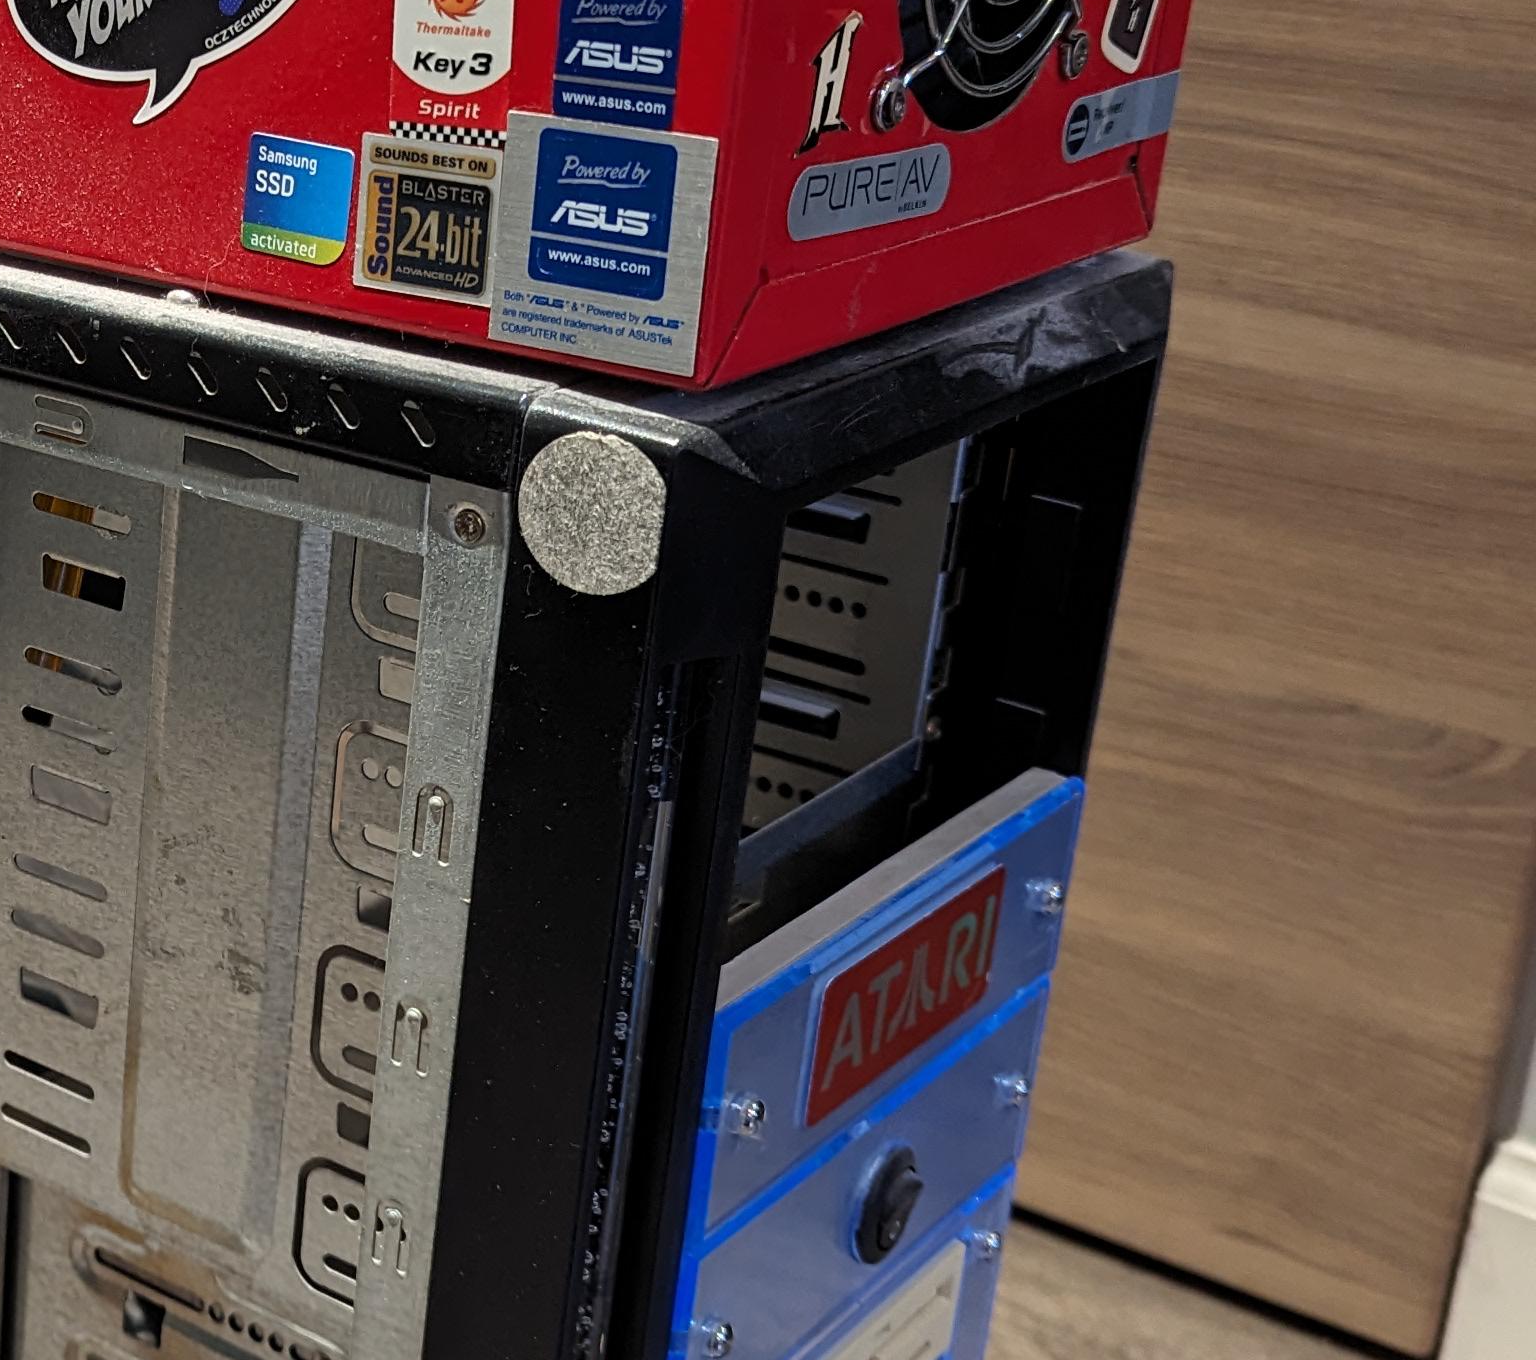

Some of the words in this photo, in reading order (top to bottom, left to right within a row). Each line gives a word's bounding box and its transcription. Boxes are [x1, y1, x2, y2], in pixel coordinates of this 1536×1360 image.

[416, 22, 491, 38] Thermaltake
[413, 50, 464, 79] Key
[469, 53, 493, 76] 3
[418, 99, 480, 120] Spirit
[562, 90, 666, 115] www.asus.com
[258, 145, 318, 175] Samsung
[374, 146, 428, 164] SOUNDS
[432, 155, 463, 170] BEST
[467, 159, 488, 173] ON
[562, 155, 625, 180] Powered
[631, 162, 651, 185] by
[255, 169, 295, 198] SSD
[402, 180, 485, 207] BLASTER
[367, 175, 394, 277] Sound
[250, 232, 317, 259] activated
[548, 248, 651, 276] www.asus.com
[395, 265, 453, 281] ADVANCED
[453, 272, 479, 288] HD
[504, 289, 524, 302] Both
[571, 302, 578, 311] &
[629, 310, 640, 323] by
[501, 322, 557, 340] COMPUTER
[502, 308, 516, 316] are
[518, 310, 562, 326] registered
[564, 318, 613, 335] trademarks
[615, 326, 625, 336] of
[628, 329, 673, 346] ASUSTek
[821, 893, 996, 1093] ATARI
